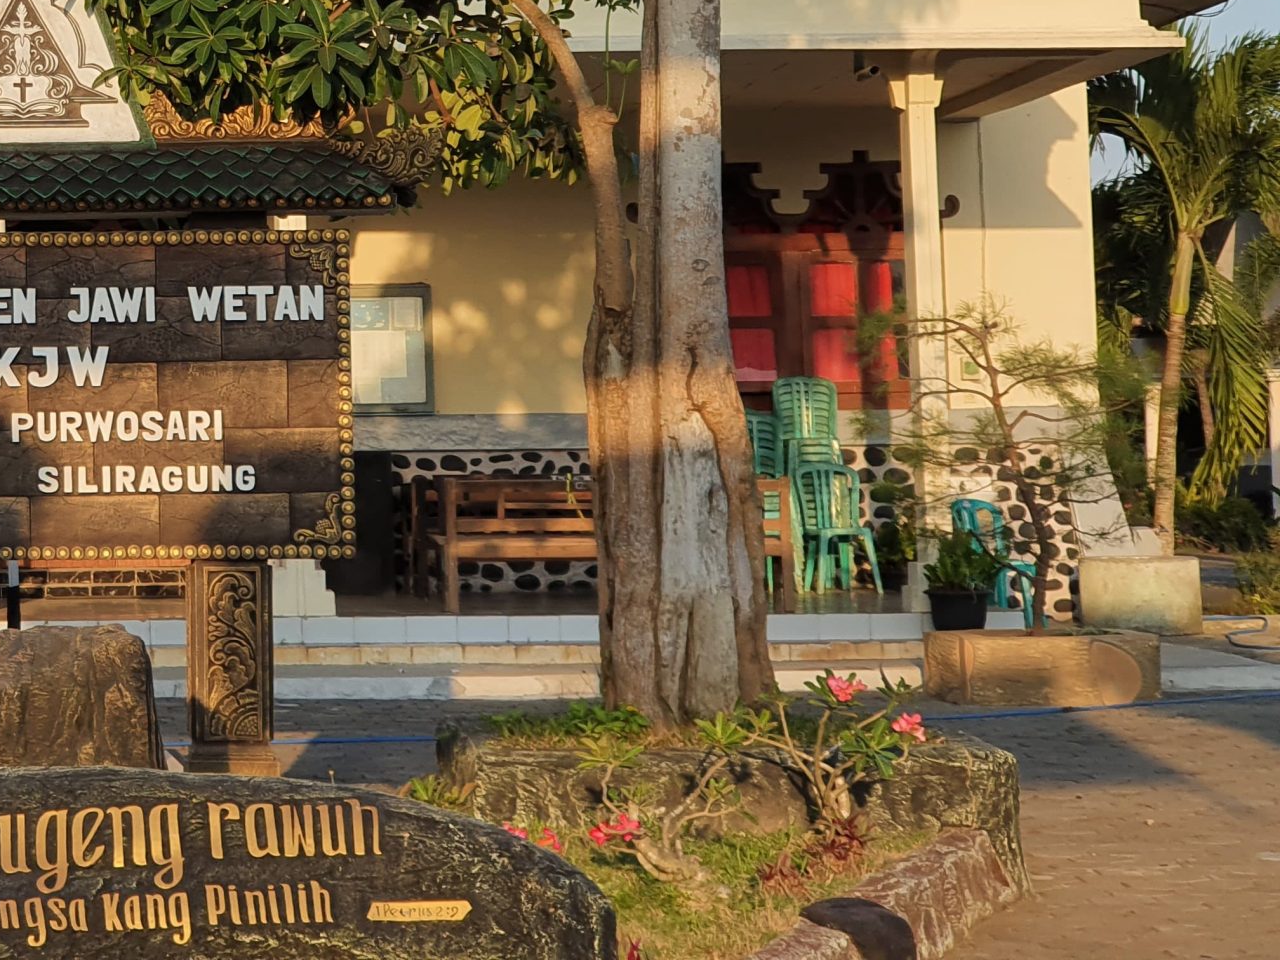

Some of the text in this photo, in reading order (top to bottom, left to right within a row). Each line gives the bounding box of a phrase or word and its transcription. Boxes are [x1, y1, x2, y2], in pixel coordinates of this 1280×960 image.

[67, 285, 157, 324] JAWI
[187, 283, 325, 322] WETAN
[10, 408, 224, 443] PURWOSARI
[36, 463, 257, 494] SILIRAGUNG
[207, 798, 383, 860] rawuh
[101, 891, 193, 946] Kang
[204, 879, 335, 926] Pinilih
